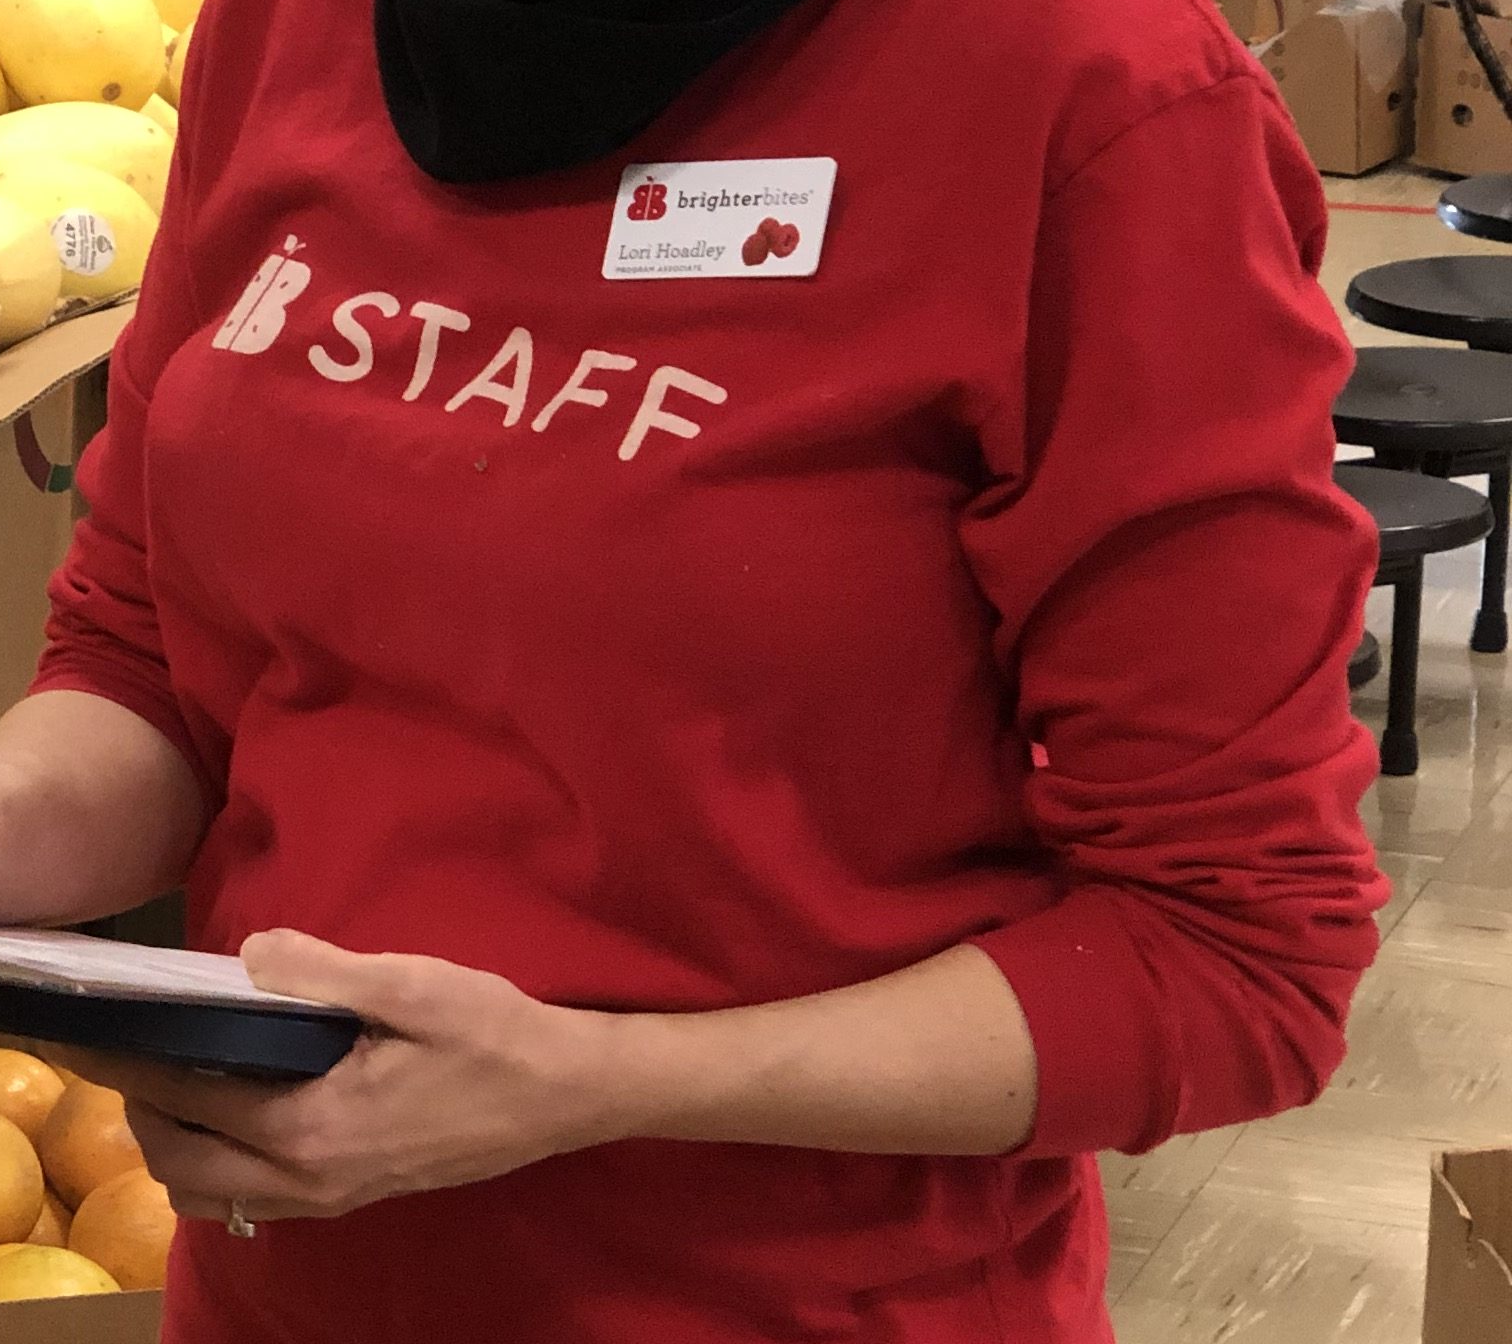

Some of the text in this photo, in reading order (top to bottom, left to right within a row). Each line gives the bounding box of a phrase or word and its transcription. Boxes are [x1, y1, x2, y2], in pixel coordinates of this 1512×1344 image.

[677, 187, 810, 212] brighterbites
[65, 223, 76, 257] 4776
[618, 240, 726, 261] Lori Hoadley
[308, 292, 728, 461] STAFF
